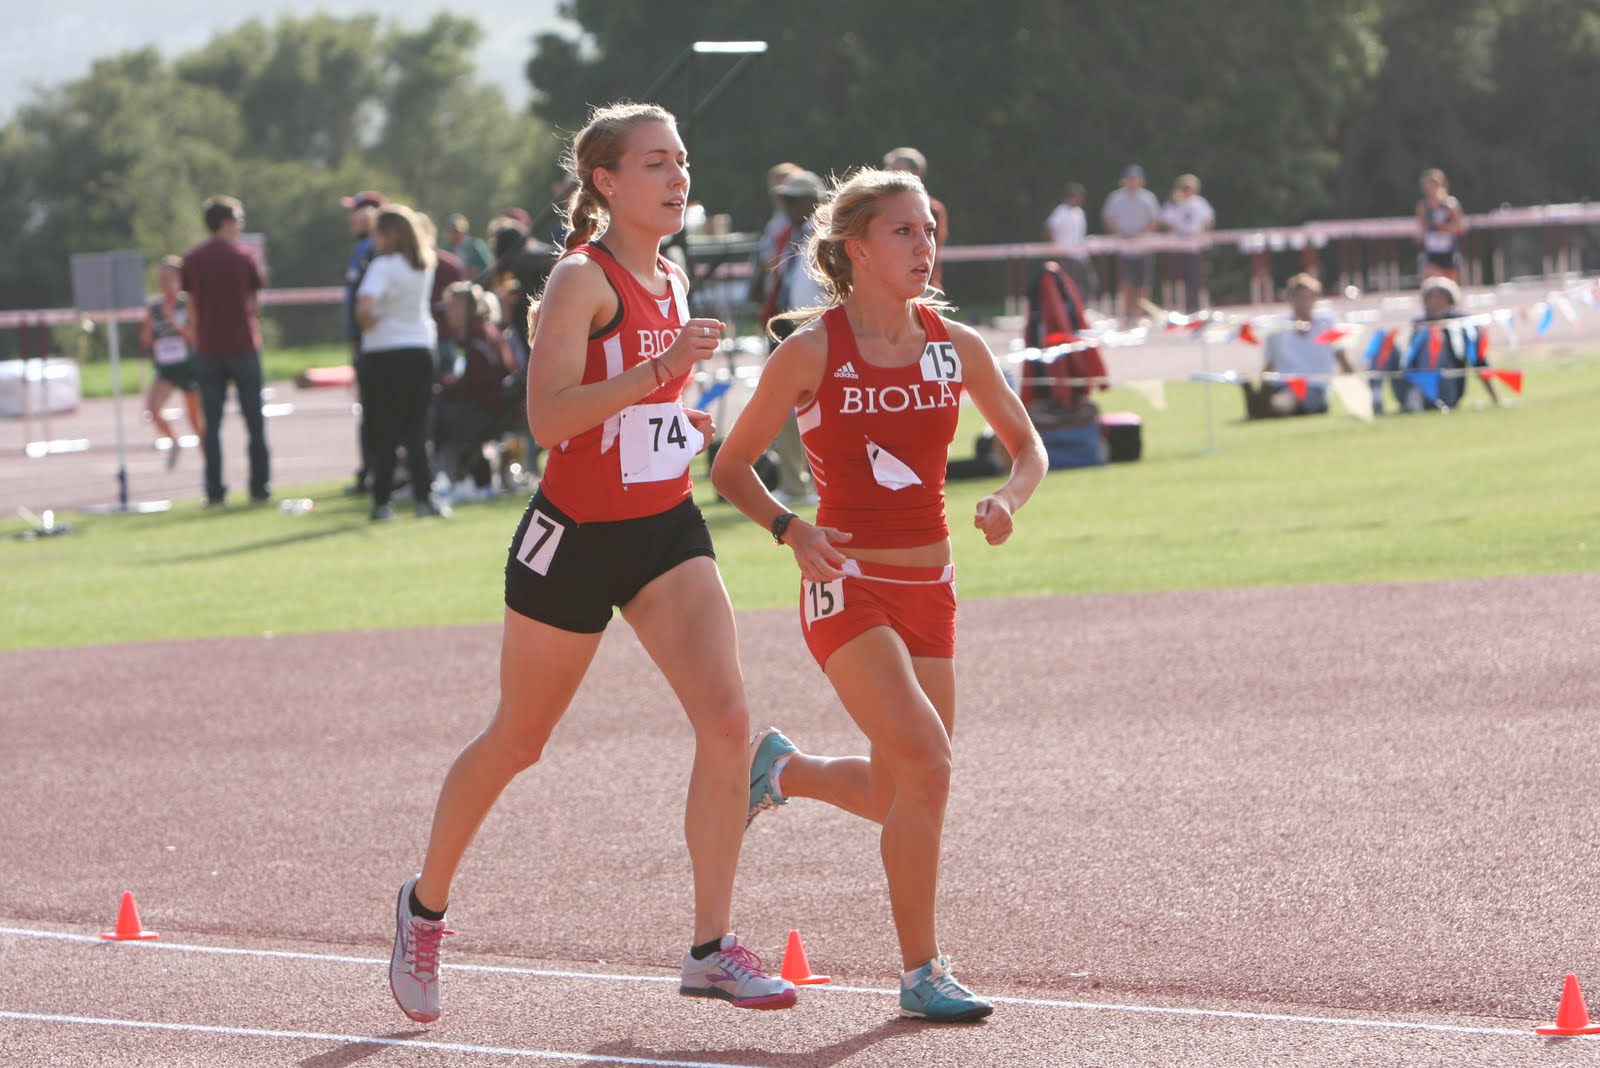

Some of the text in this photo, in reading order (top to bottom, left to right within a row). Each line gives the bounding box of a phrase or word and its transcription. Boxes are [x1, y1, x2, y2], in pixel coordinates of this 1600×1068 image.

[834, 371, 859, 380] adidas
[925, 344, 956, 379] 15
[839, 381, 957, 414] BIOLA
[648, 415, 687, 452] 74
[524, 515, 556, 564] 7
[809, 580, 835, 618] 15
